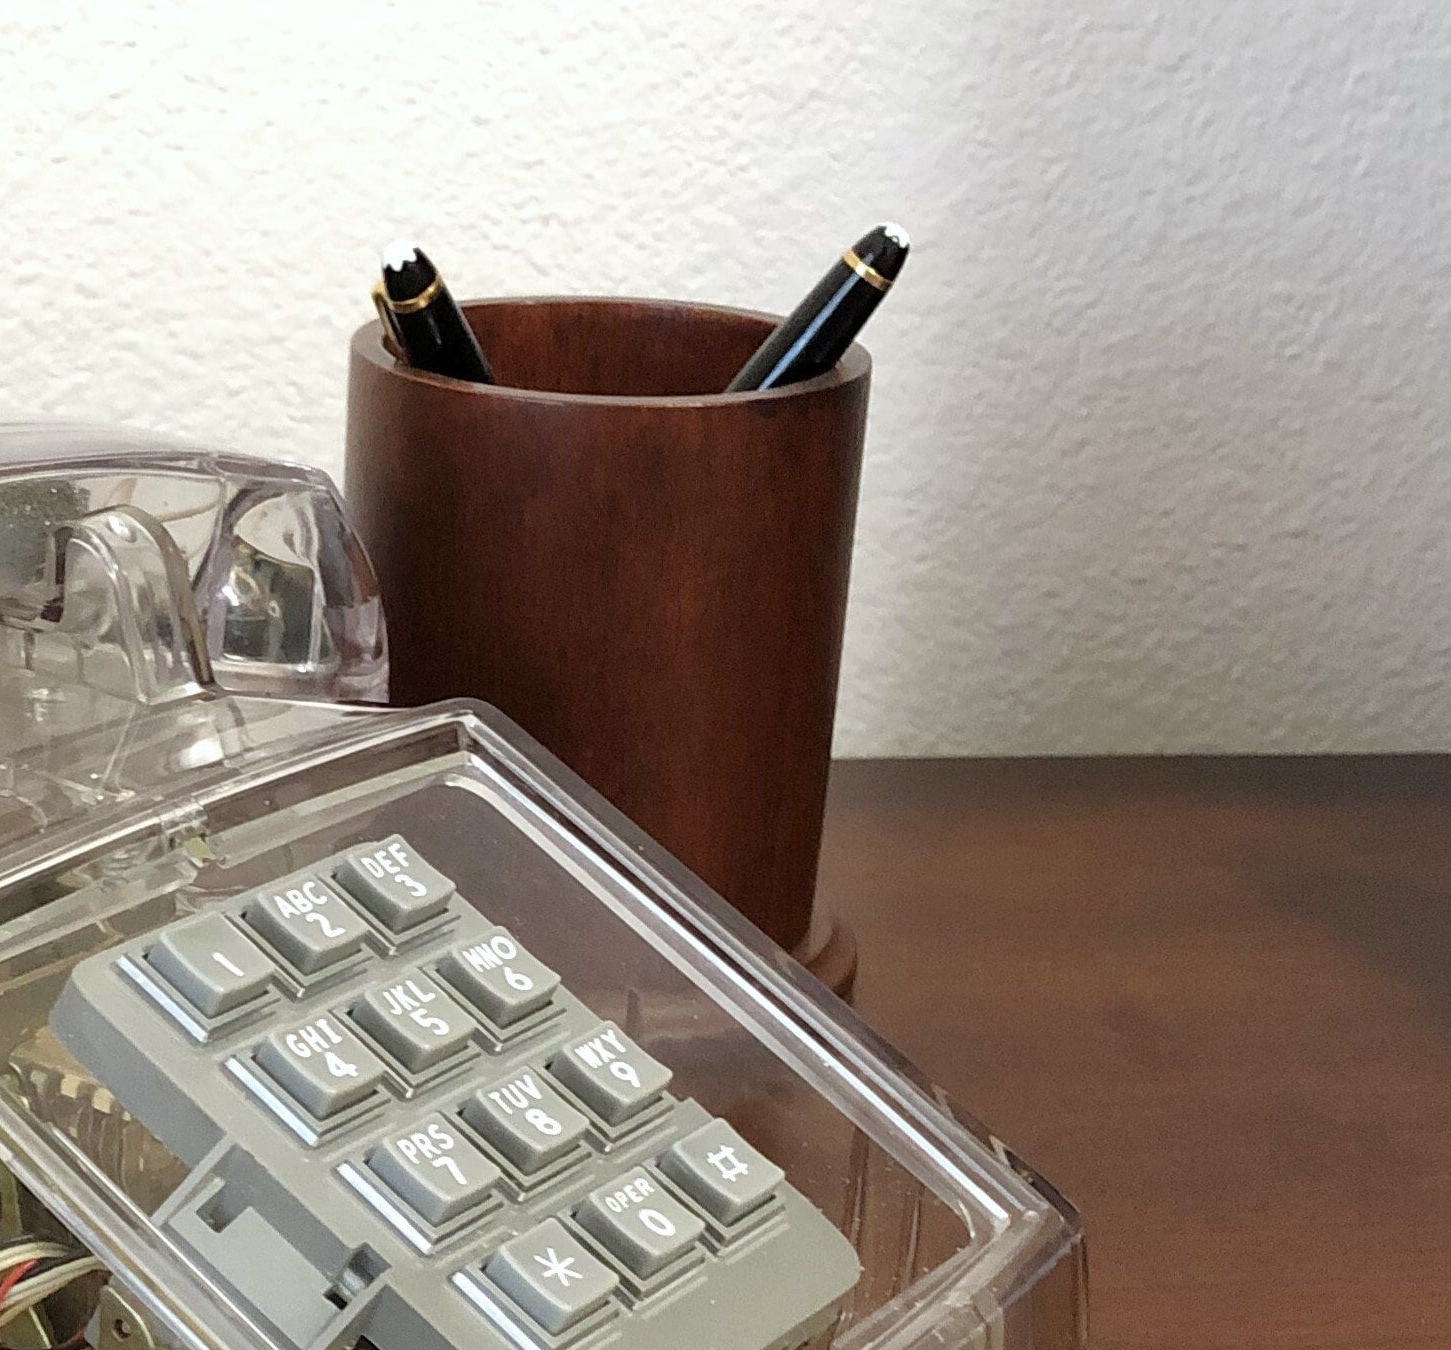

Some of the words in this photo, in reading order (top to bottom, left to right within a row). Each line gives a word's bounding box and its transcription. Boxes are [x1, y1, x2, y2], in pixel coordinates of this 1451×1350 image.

[361, 843, 412, 878] DEF
[273, 881, 328, 919] ABC
[393, 873, 428, 898] 3
[305, 911, 345, 938] 2
[211, 951, 245, 977] 1
[462, 935, 517, 974] MNO
[504, 968, 534, 991] 6
[383, 980, 436, 1016] JKL
[286, 1018, 343, 1058] GHI
[410, 1008, 449, 1036] 5
[324, 1051, 359, 1078] 4
[573, 1030, 628, 1069] WXY
[614, 1062, 641, 1088] 9
[488, 1075, 541, 1115] TUV
[524, 1108, 563, 1136] 8
[396, 1124, 454, 1165] PRS
[432, 1156, 467, 1185] 7
[705, 1145, 749, 1182] #
[604, 1178, 656, 1214] OPER
[639, 1208, 677, 1237] 0
